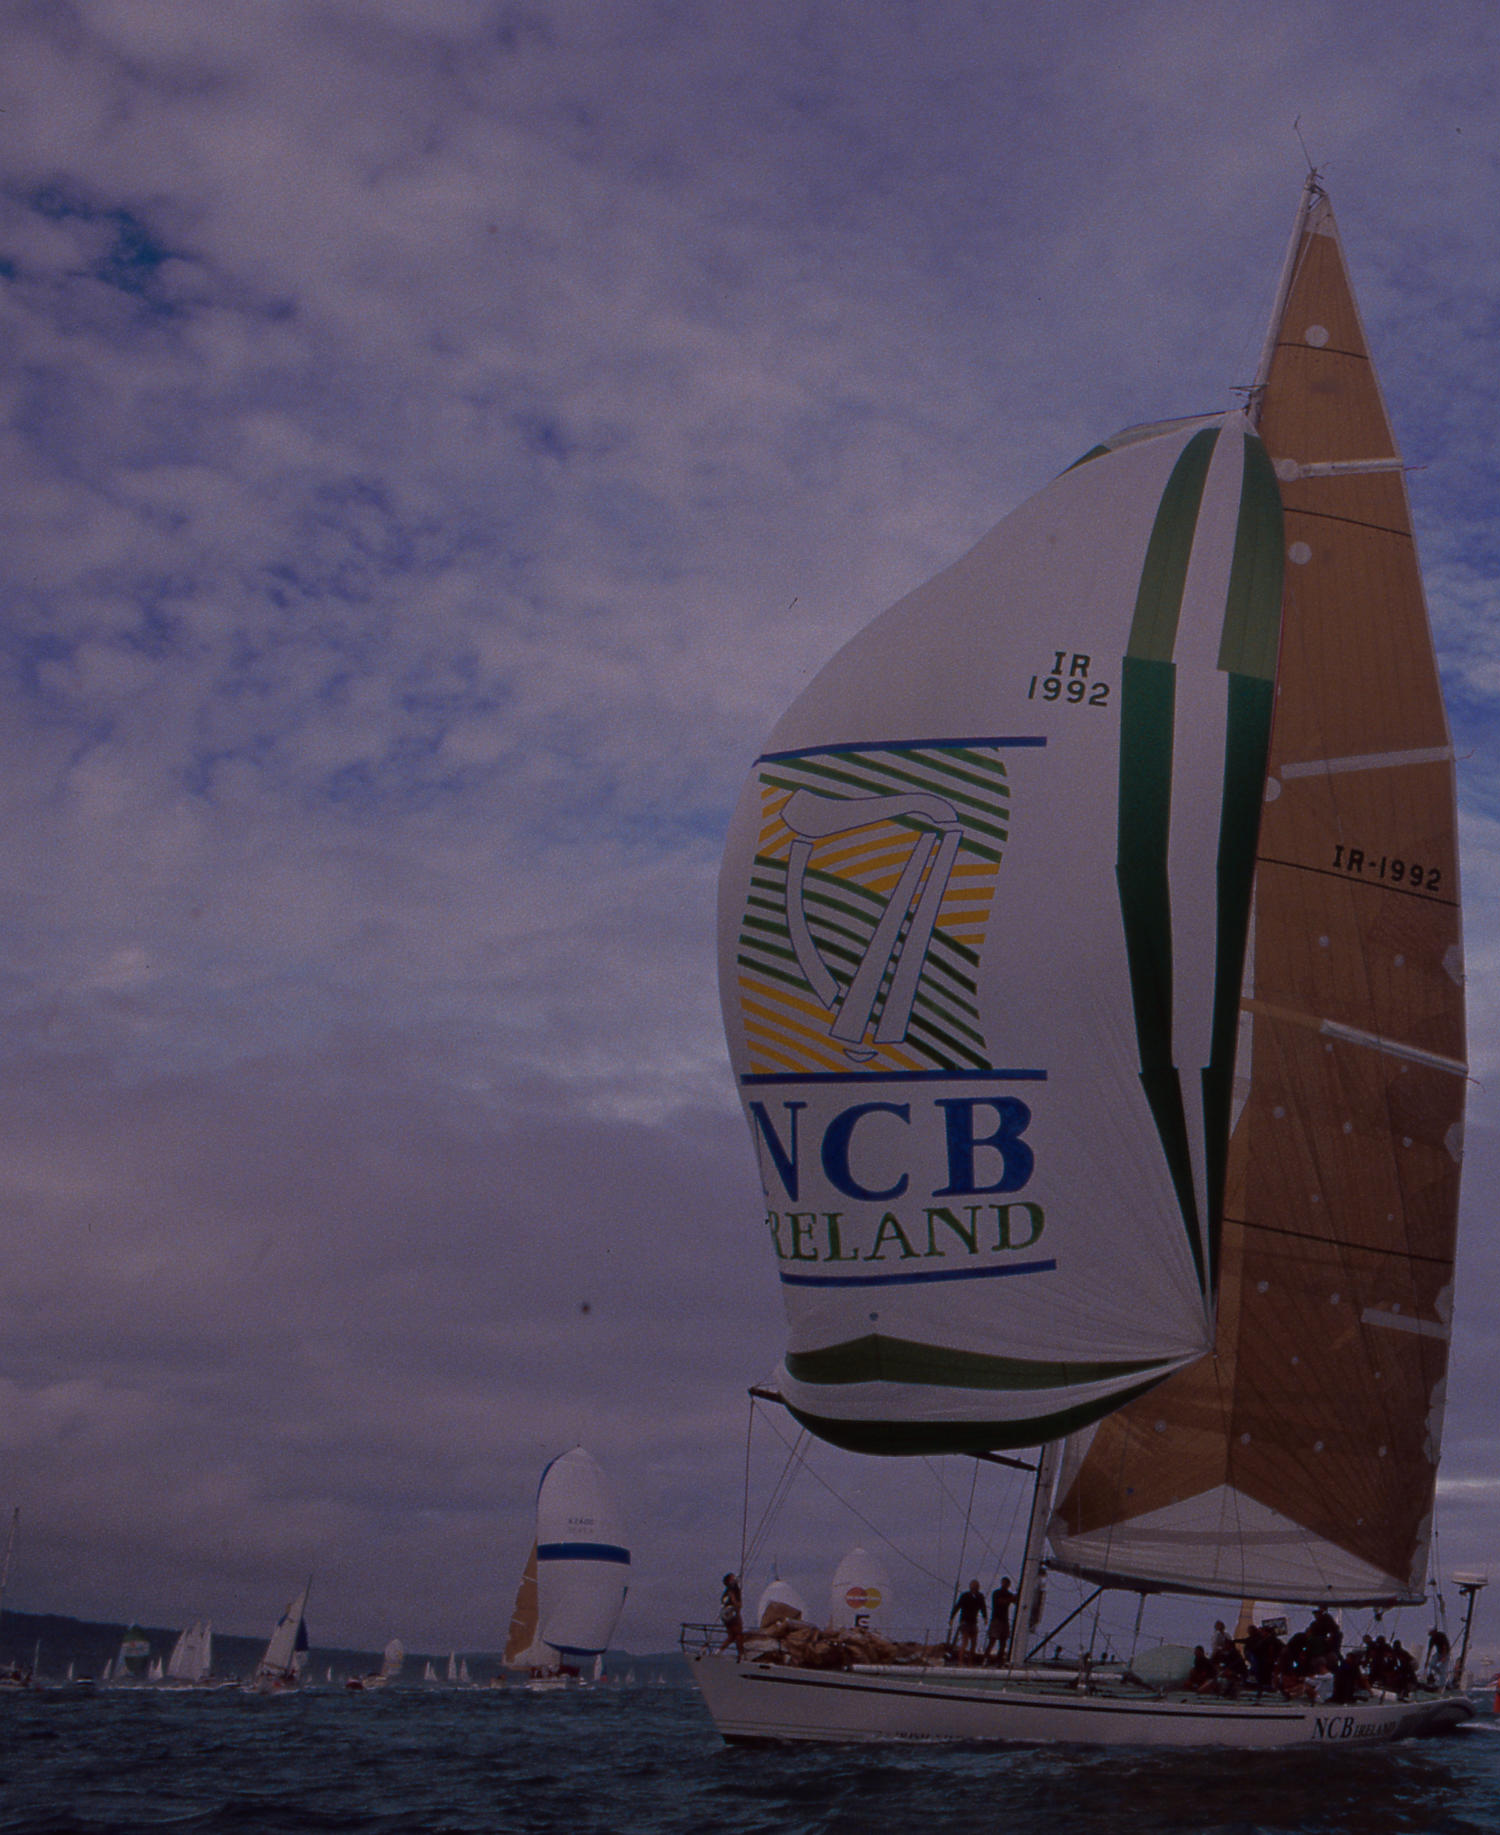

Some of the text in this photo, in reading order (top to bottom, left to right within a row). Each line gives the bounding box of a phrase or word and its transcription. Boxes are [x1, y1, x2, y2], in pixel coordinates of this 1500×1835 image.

[1051, 651, 1091, 678] IR
[1028, 675, 1110, 707] 1992
[1333, 844, 1441, 891] IR-1992
[750, 1096, 1035, 1202] NCB
[766, 1201, 1046, 1262] RELAND
[1312, 1716, 1354, 1739] NCB
